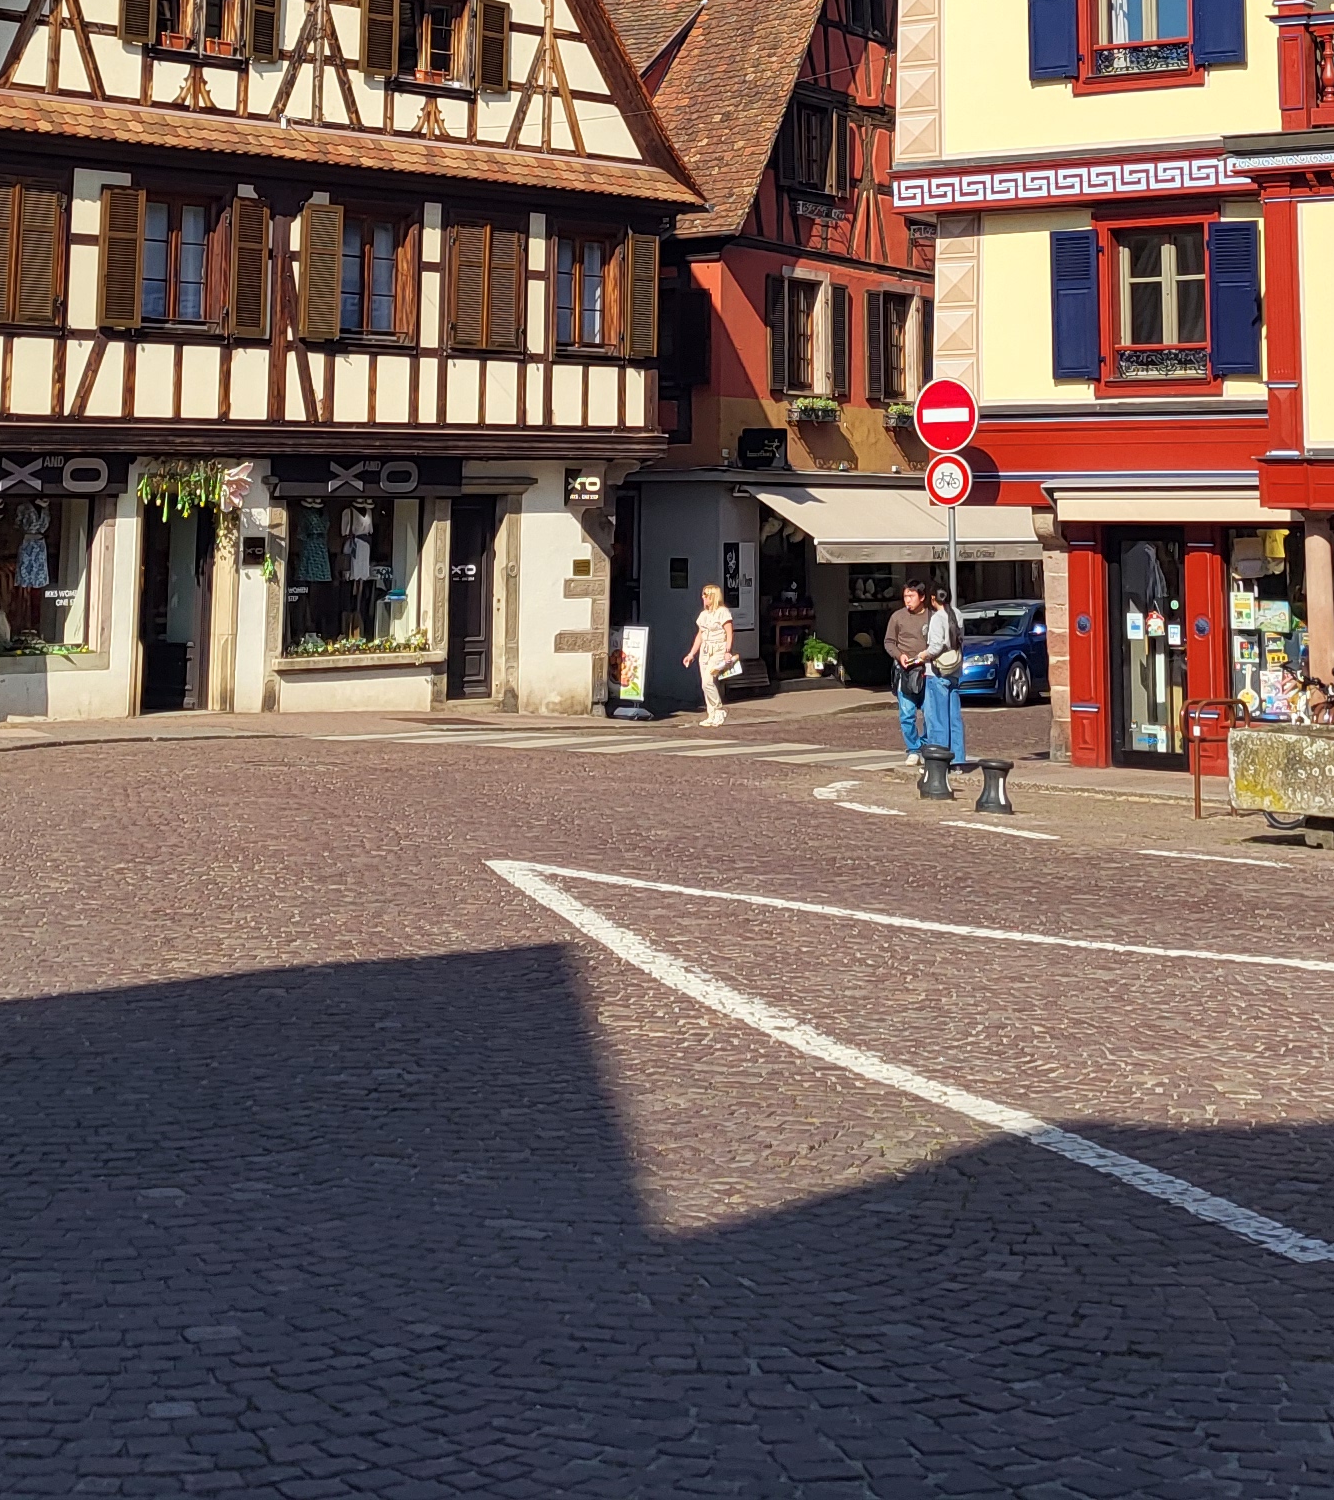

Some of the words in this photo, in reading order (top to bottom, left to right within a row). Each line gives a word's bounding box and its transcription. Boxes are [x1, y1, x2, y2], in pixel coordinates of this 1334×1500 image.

[0, 457, 42, 492] X
[43, 456, 64, 467] AND
[63, 457, 108, 492] O
[329, 461, 364, 492] X
[380, 461, 418, 492] O
